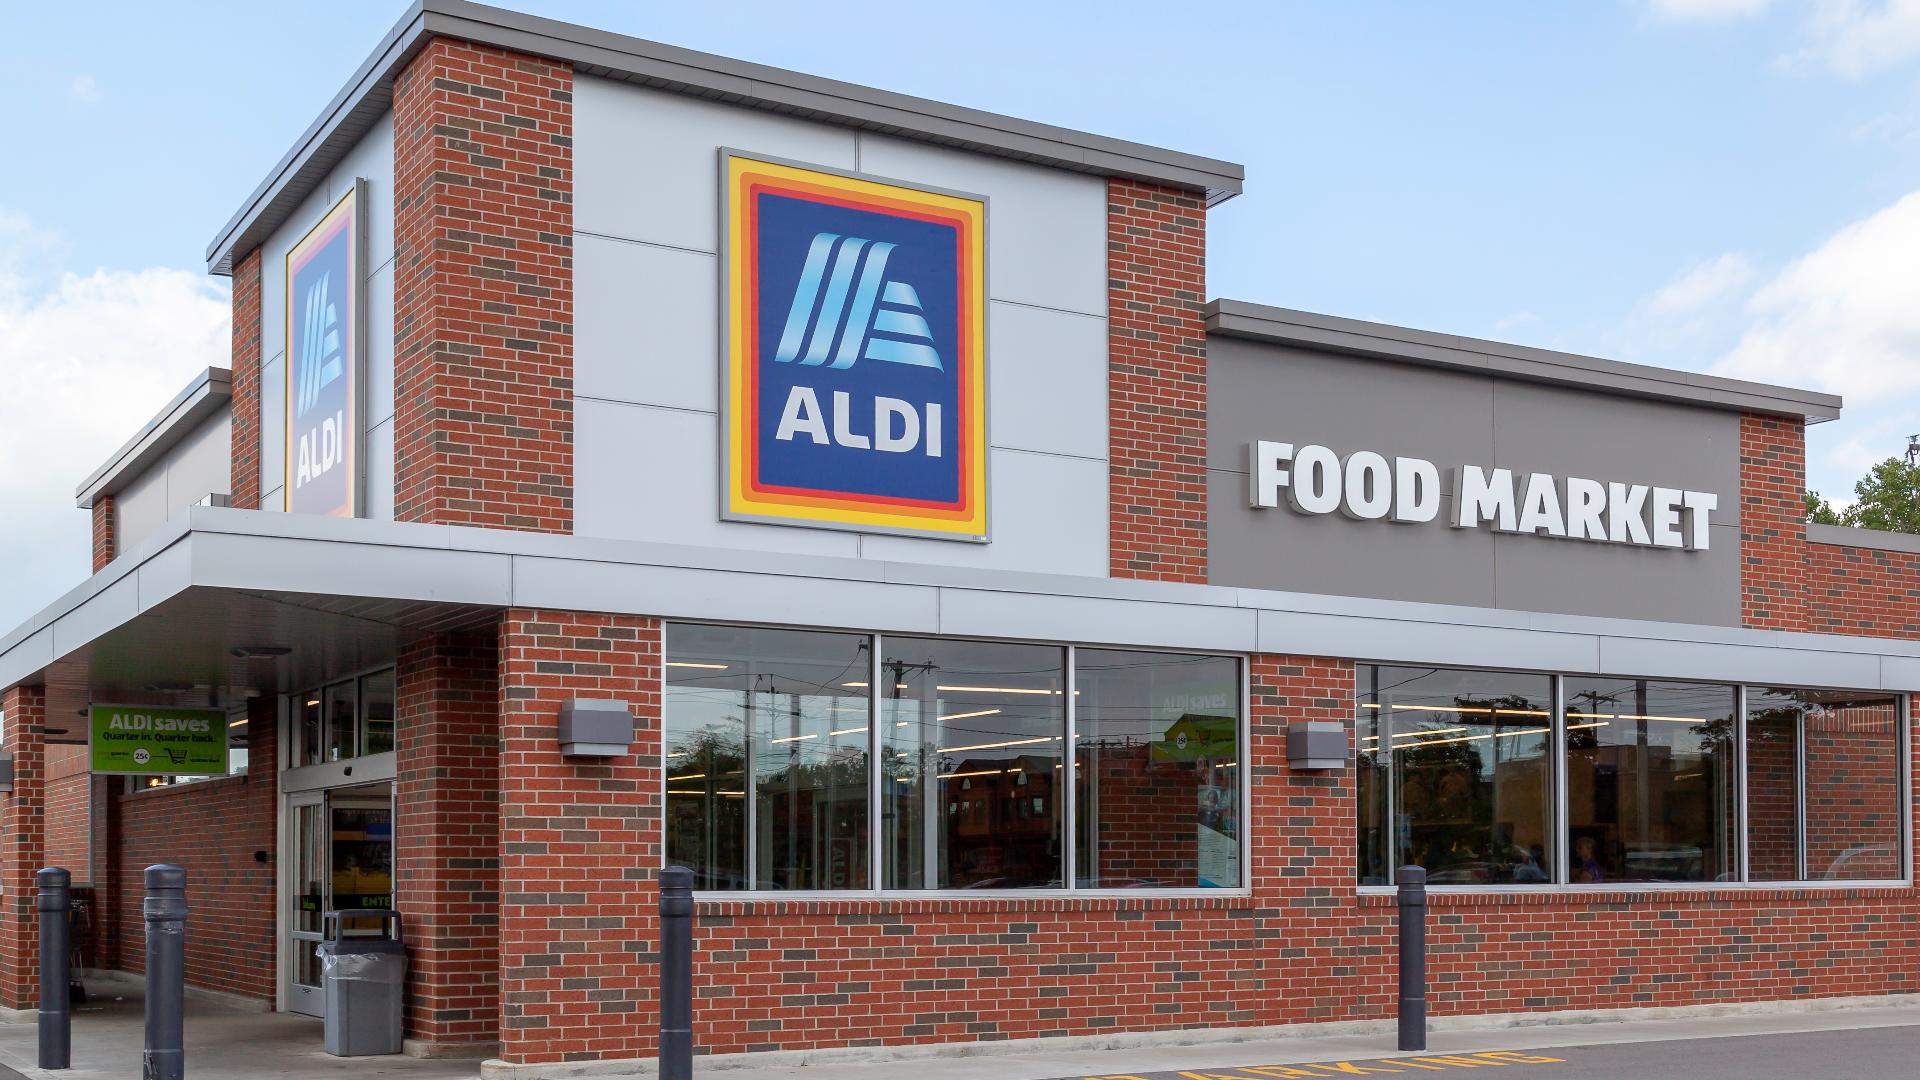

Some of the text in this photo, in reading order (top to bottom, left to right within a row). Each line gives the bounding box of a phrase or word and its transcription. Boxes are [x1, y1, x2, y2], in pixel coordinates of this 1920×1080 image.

[775, 385, 942, 458] ALDI
[296, 409, 343, 489] ALDI
[1251, 439, 1718, 551] FOOD MARKET
[103, 731, 140, 742] Quarter
[141, 732, 152, 742] in.
[154, 733, 191, 743] Quarter
[109, 713, 210, 732] ALDI saves
[362, 896, 391, 907] ENTE
